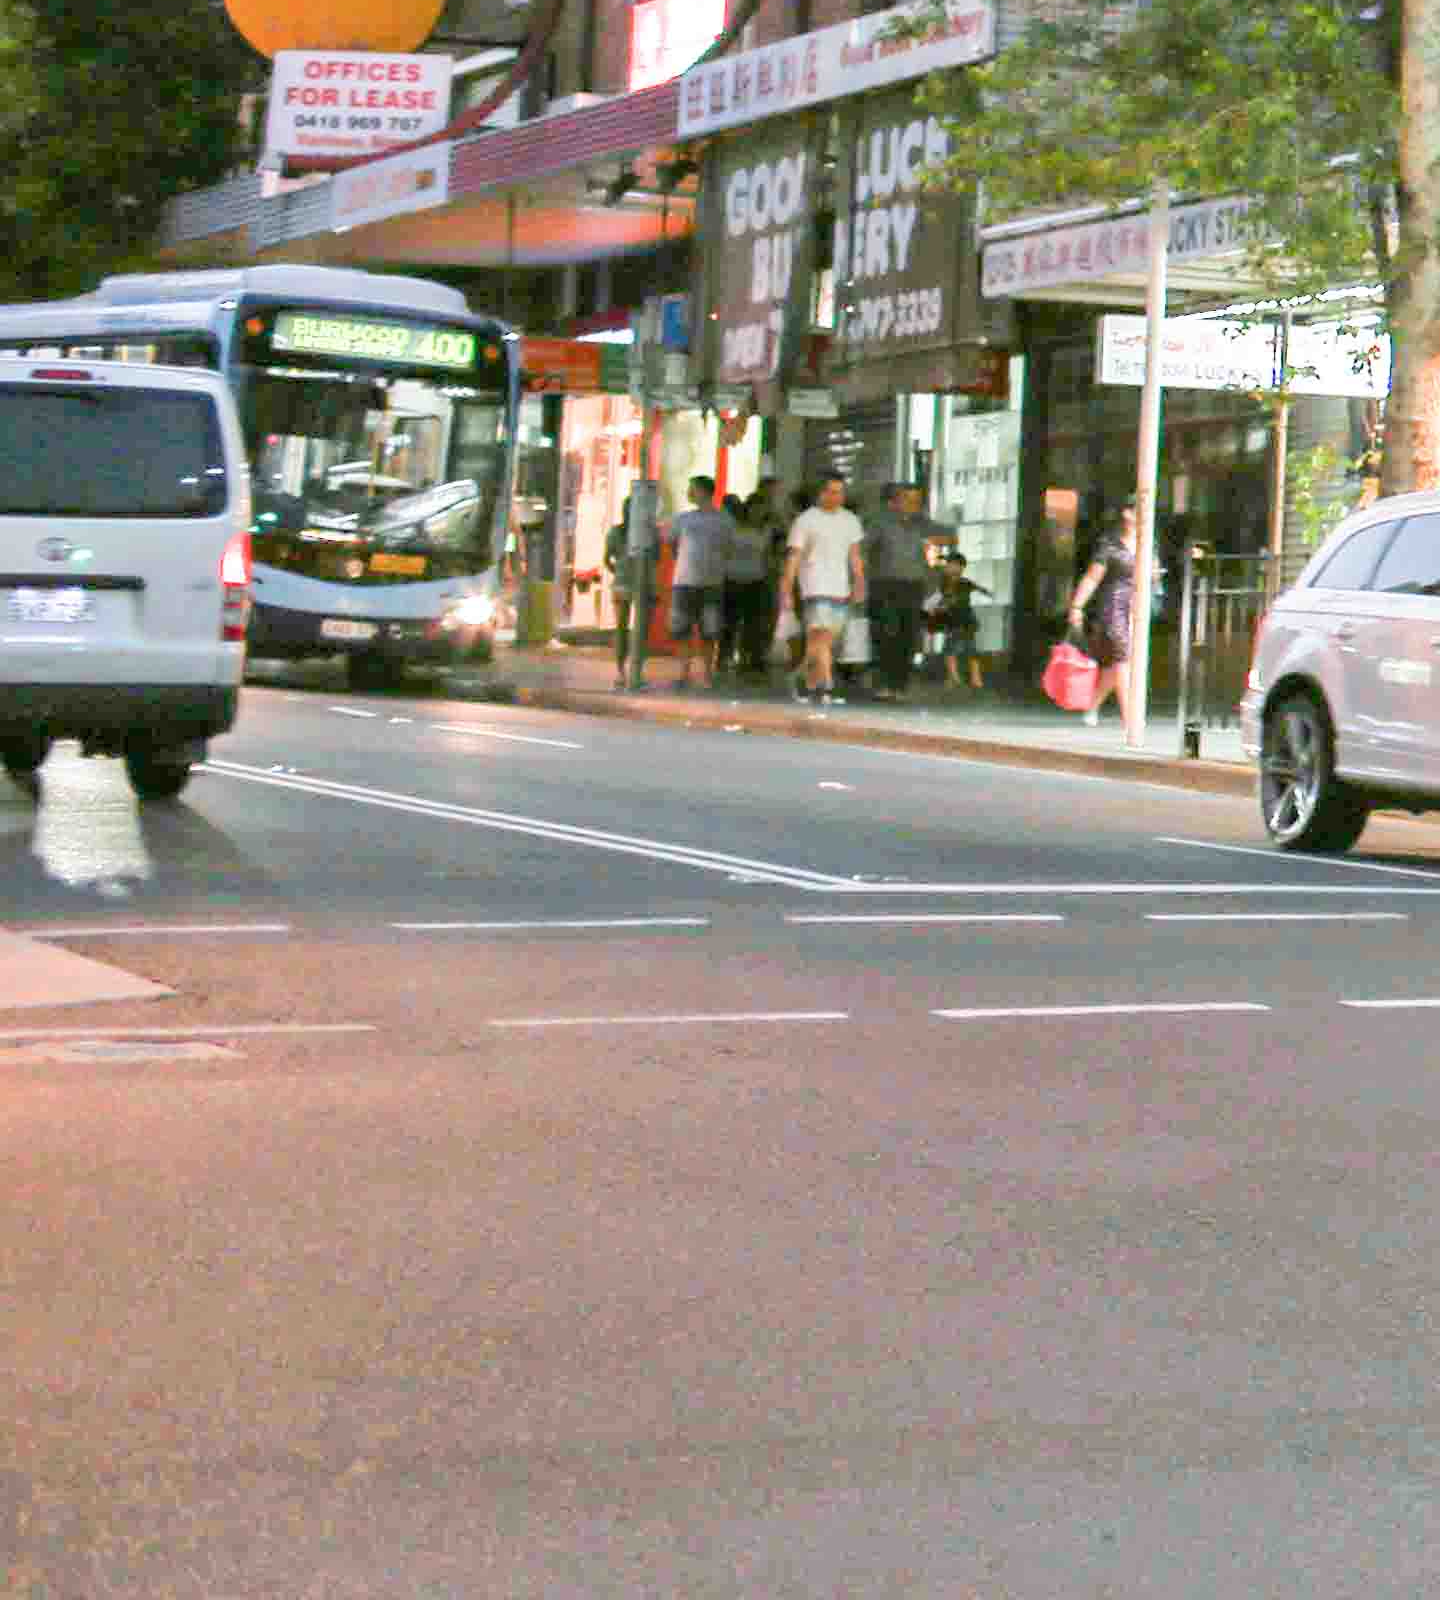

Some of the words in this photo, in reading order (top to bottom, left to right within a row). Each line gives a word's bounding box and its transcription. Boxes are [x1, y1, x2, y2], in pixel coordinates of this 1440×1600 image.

[304, 61, 421, 84] OFFICES
[285, 87, 338, 107] FOR
[350, 89, 437, 111] LEASE
[415, 330, 475, 364] 400
